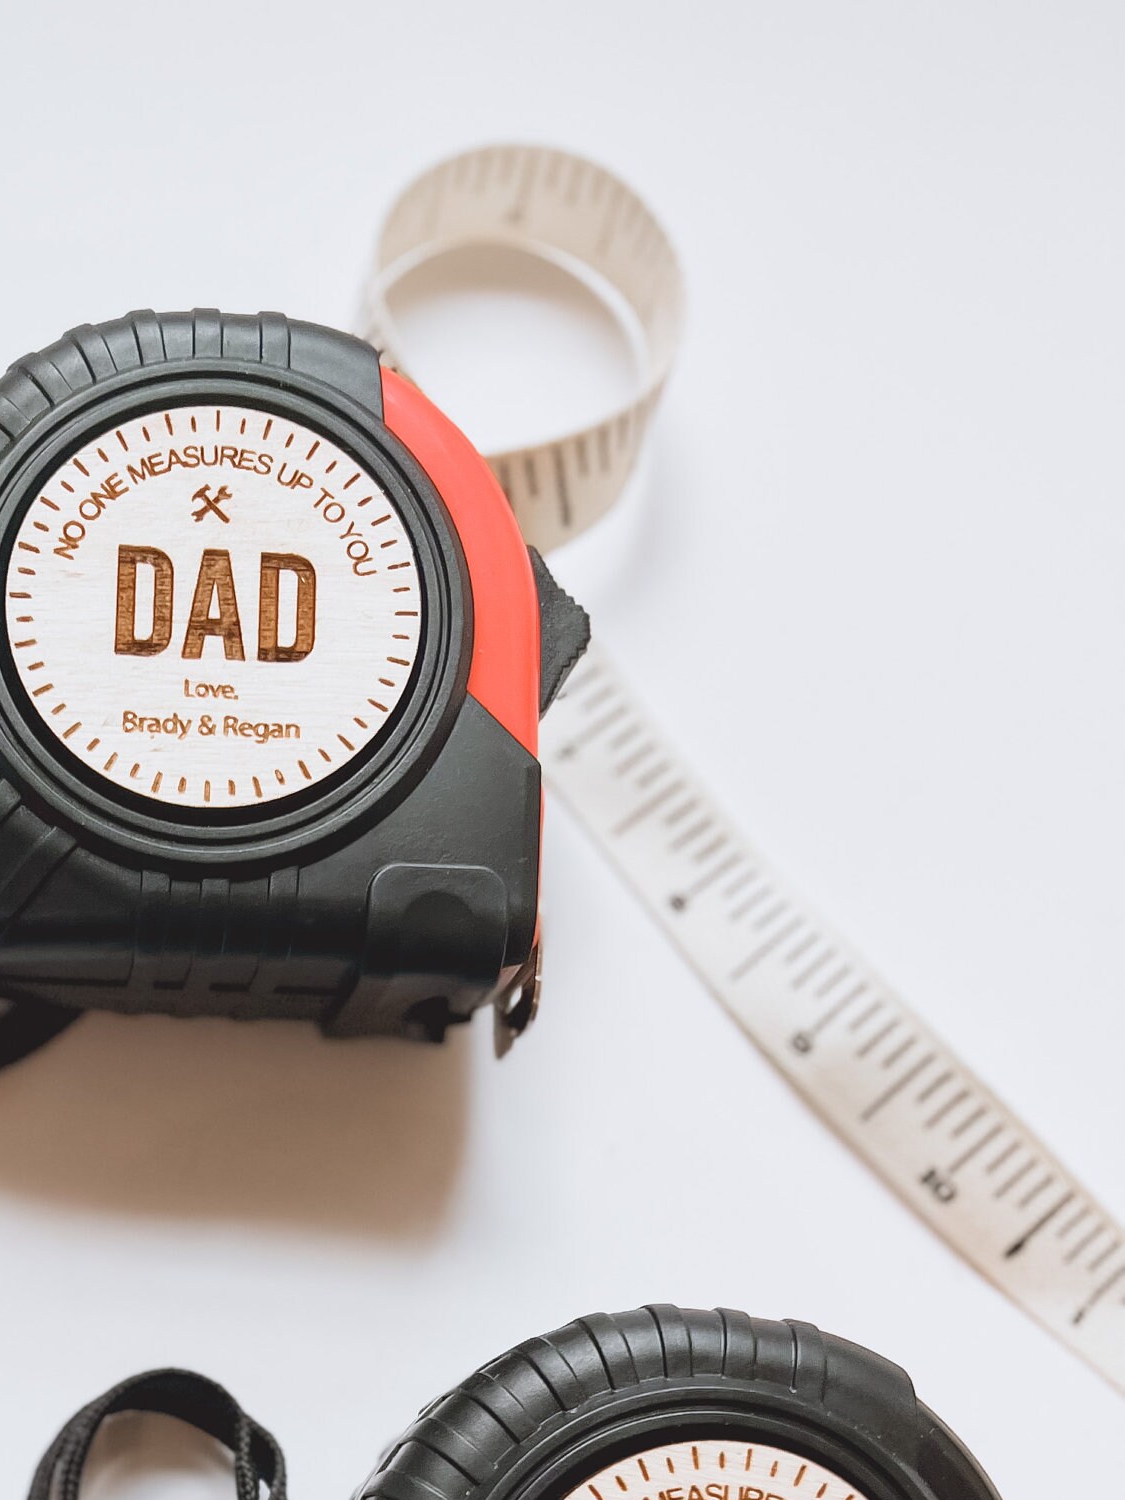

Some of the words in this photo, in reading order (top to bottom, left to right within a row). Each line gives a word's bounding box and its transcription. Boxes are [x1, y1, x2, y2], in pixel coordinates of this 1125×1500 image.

[53, 519, 86, 560] NO
[79, 473, 130, 521] ONE
[127, 445, 274, 485] MEASURES
[277, 463, 314, 492] UP
[312, 487, 346, 524] TO
[338, 521, 378, 577] YOU
[114, 544, 317, 662] DAD
[122, 711, 192, 738] Brady
[198, 715, 217, 737] &
[223, 716, 301, 744] Regan
